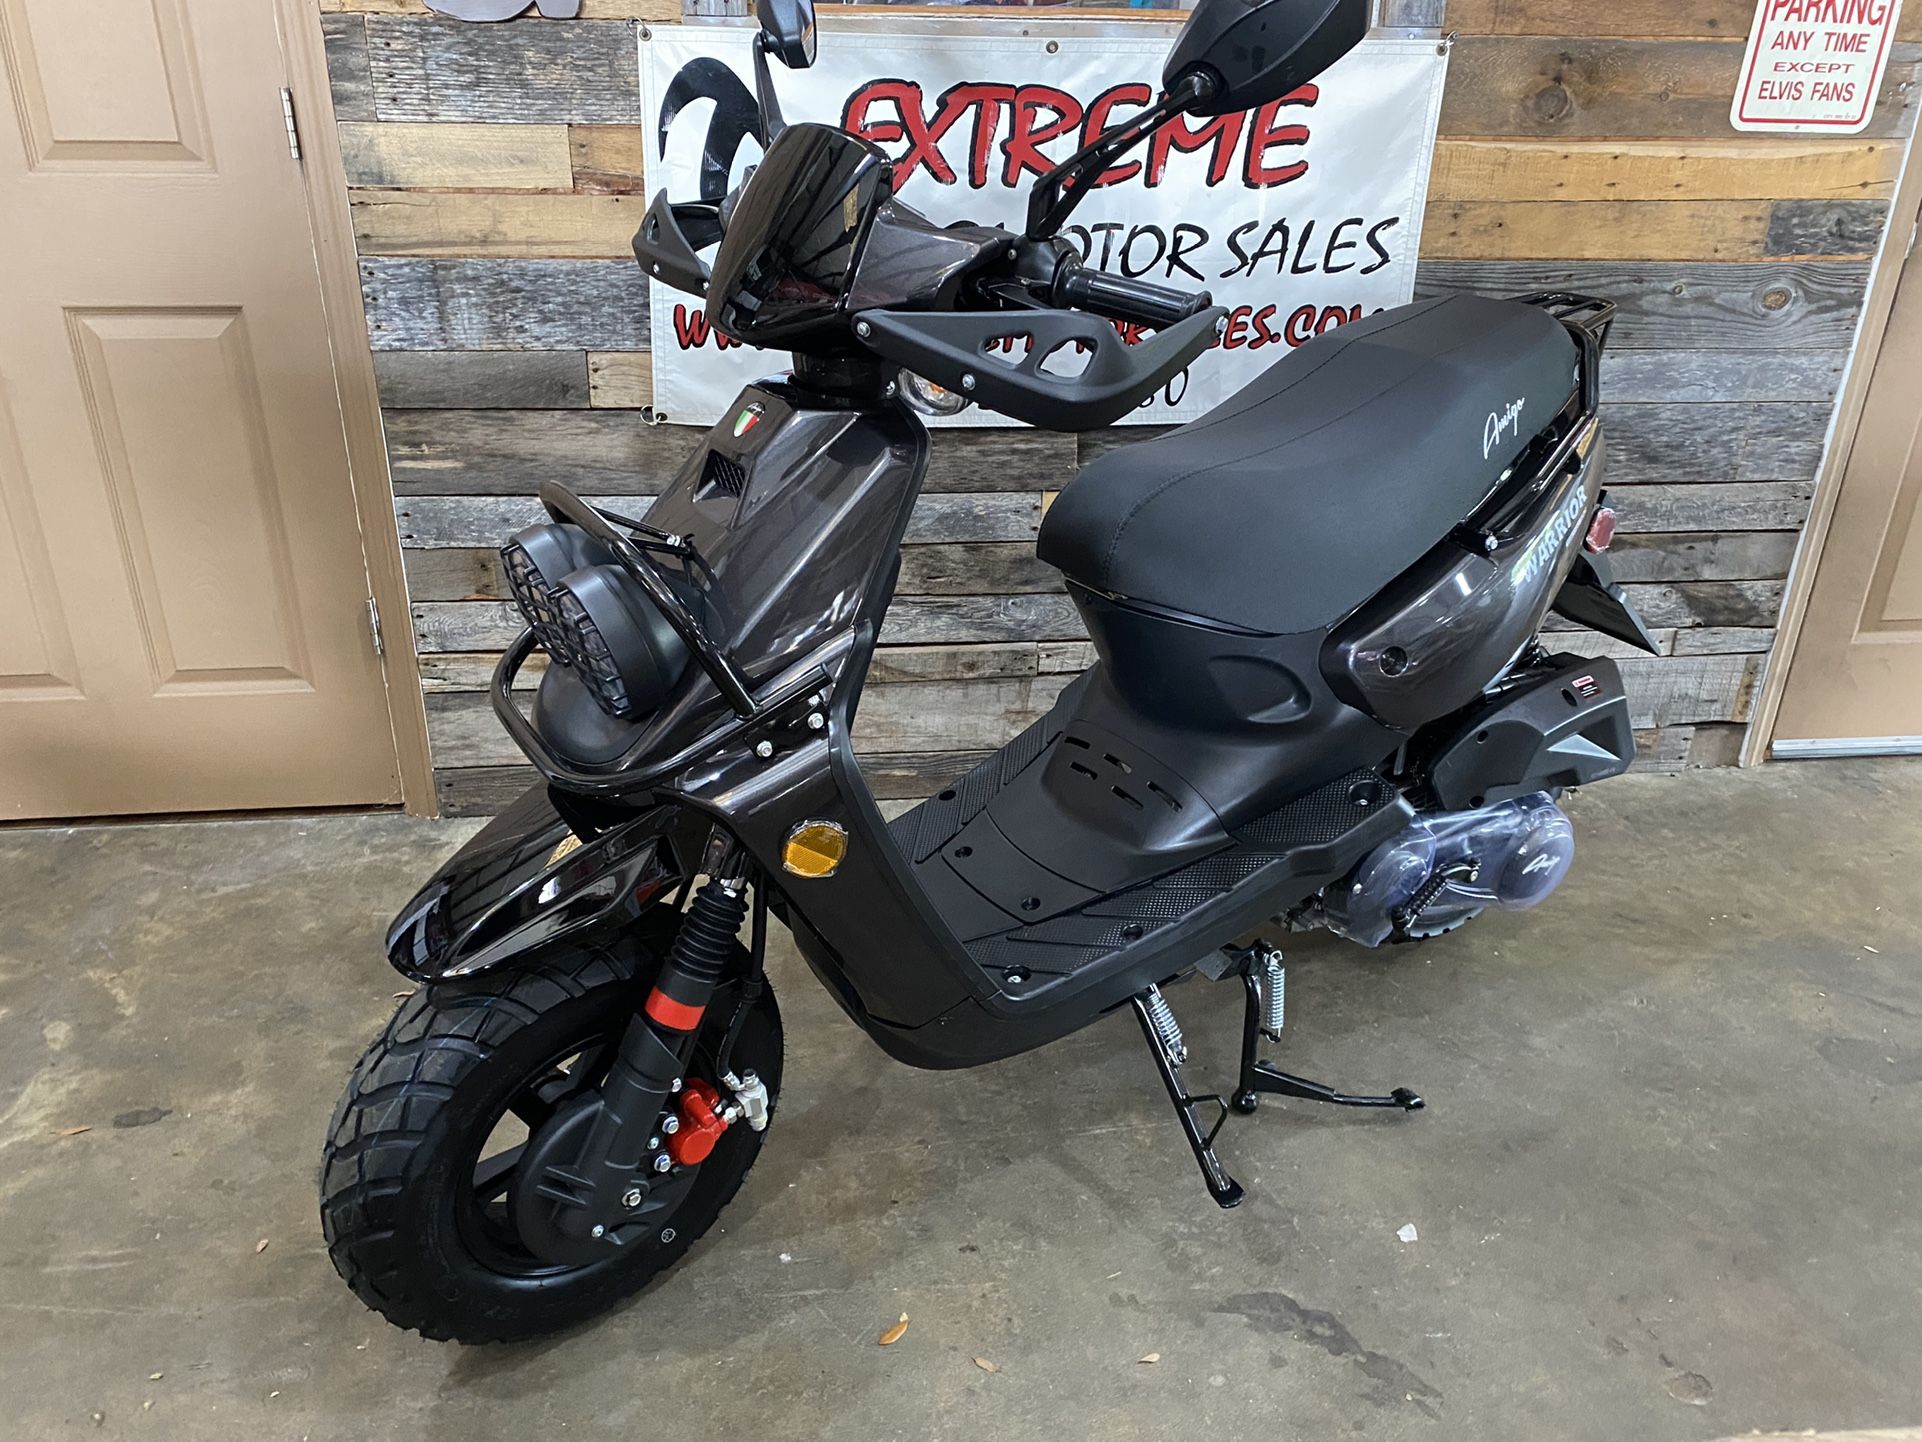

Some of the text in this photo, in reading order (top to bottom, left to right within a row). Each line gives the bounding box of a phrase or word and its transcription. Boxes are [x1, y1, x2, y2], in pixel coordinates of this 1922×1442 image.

[1770, 0, 1887, 25] PARKING
[1771, 31, 1871, 52] ANY TIME
[1773, 62, 1856, 74] EXCEPT
[1758, 81, 1855, 102] ELVIS FANS
[1045, 217, 1400, 282] OTOR SALES
[1483, 397, 1525, 460] Amigo
[1522, 484, 1587, 583] WARRIOR
